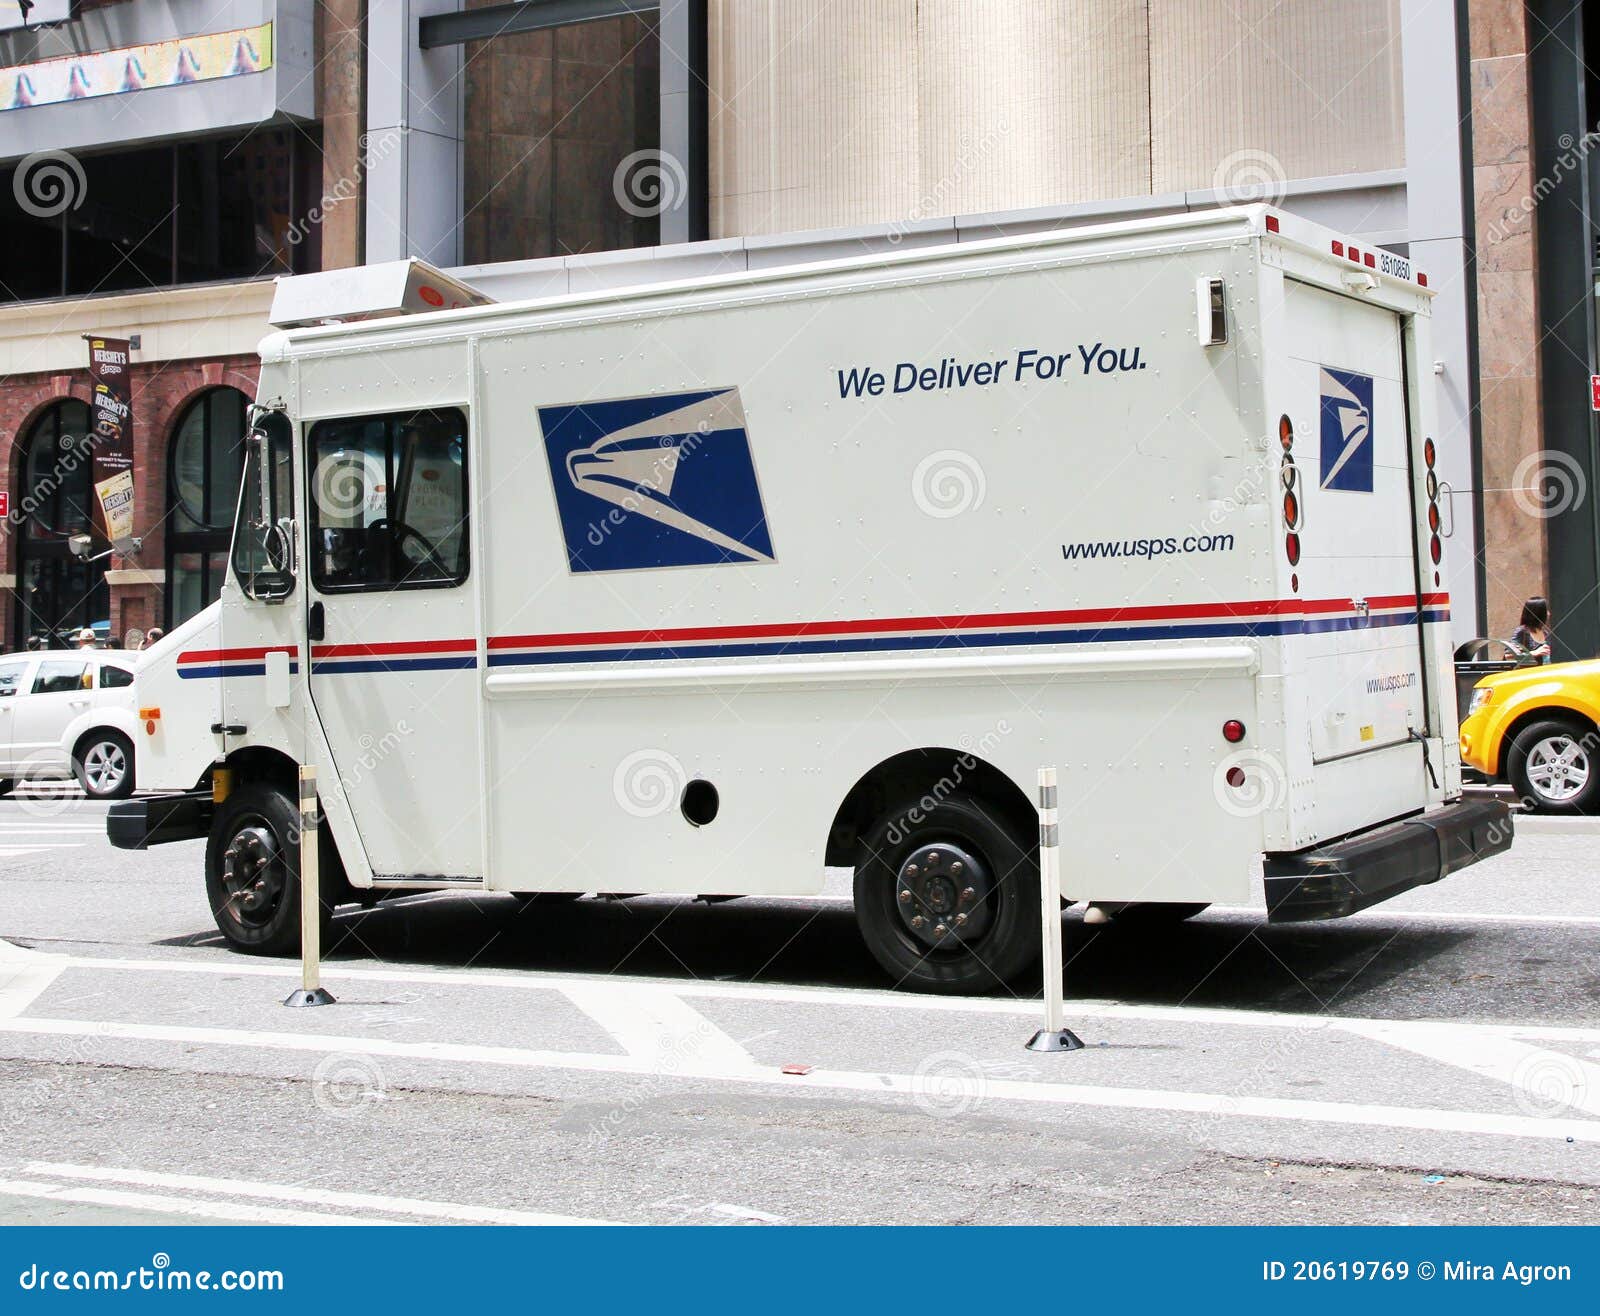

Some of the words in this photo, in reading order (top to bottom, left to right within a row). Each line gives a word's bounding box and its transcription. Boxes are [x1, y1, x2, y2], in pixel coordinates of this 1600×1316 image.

[1381, 254, 1410, 280] 3510850
[837, 367, 885, 398] We
[893, 358, 1008, 393] Deliver
[1015, 350, 1071, 381] For
[1078, 342, 1146, 374] You.
[1062, 534, 1234, 560] www.usps.com
[1366, 672, 1416, 695] www.usps.com
